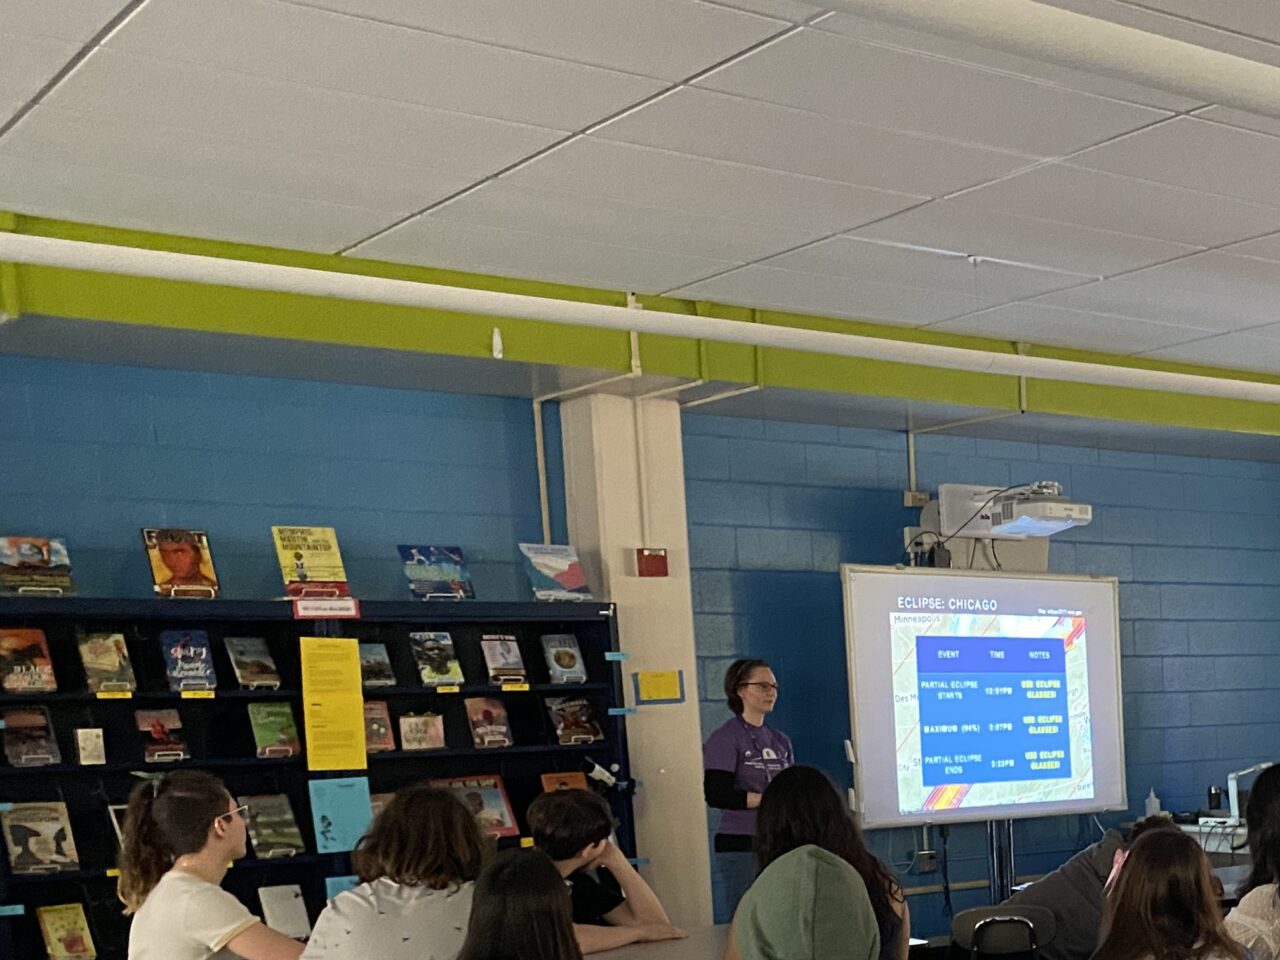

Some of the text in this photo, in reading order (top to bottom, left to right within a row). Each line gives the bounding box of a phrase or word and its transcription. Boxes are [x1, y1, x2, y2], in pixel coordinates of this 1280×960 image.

[897, 596, 998, 611] ECLIPSE: CHICAGO
[937, 650, 1051, 660] EVENT TIME NOTES
[920, 680, 979, 689] PARTIAL ECLIPSE
[924, 753, 983, 765] PARTIAL ECLIPSE
